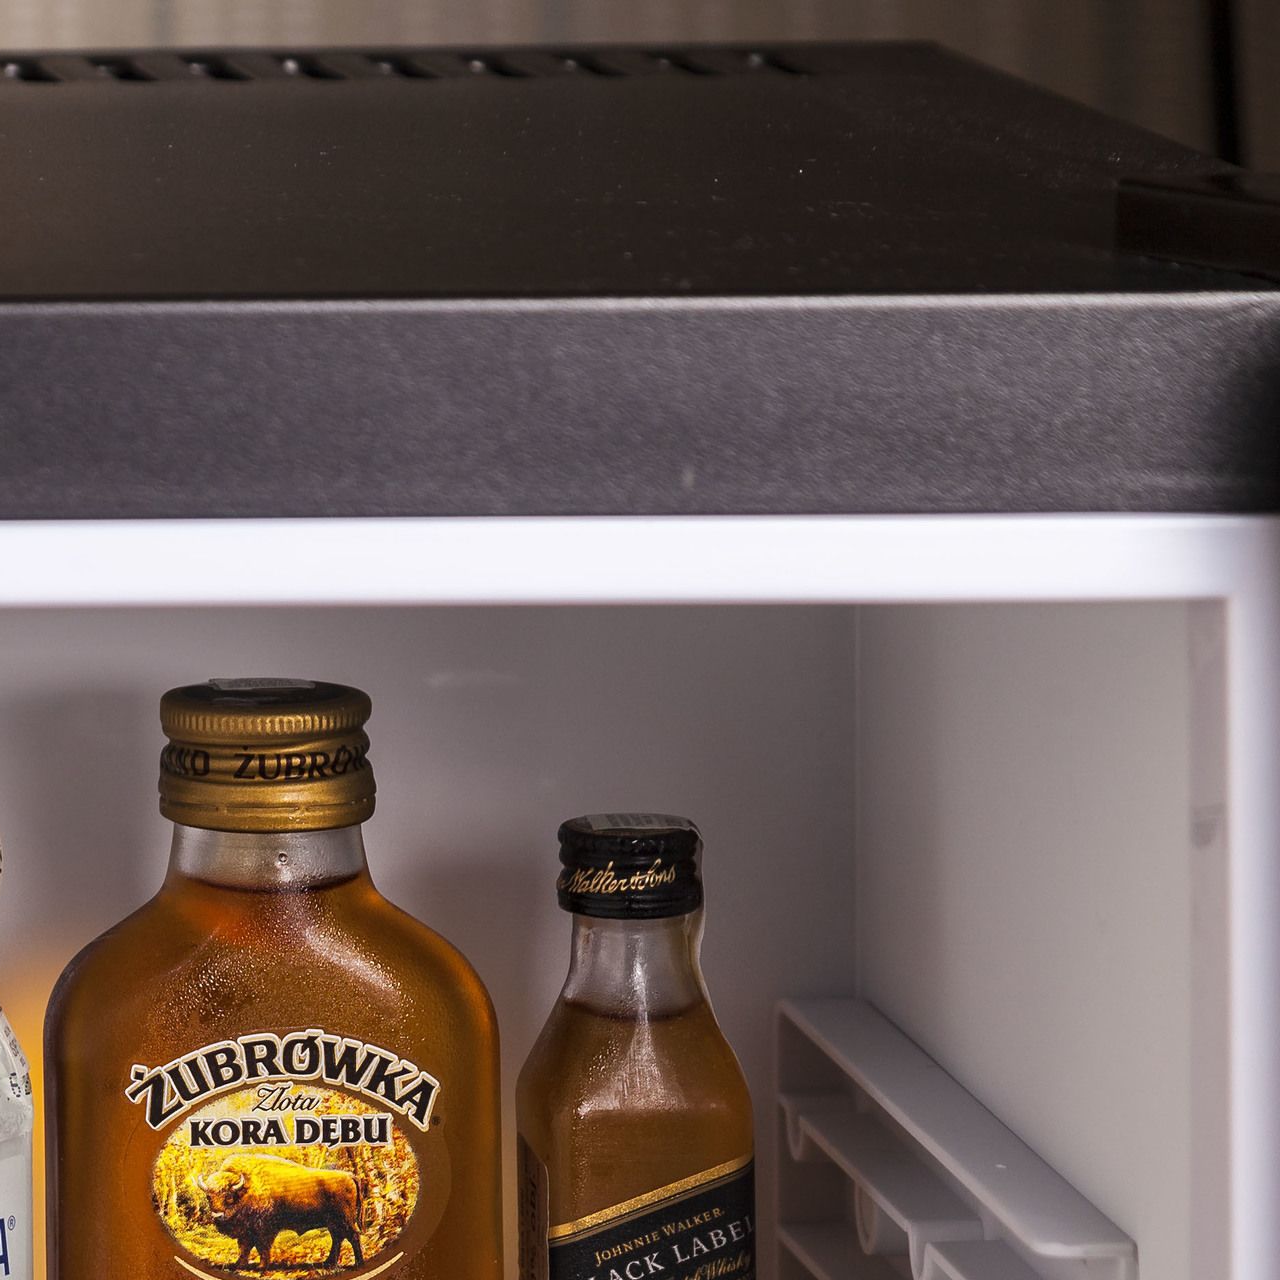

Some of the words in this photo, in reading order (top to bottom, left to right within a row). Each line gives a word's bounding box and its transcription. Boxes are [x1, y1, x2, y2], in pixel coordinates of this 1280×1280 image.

[126, 1029, 441, 1132] ŻUBRÓWKA
[251, 1084, 321, 1113] Złota
[189, 1119, 287, 1147] KORA
[293, 1115, 390, 1147] DĘBU
[594, 1232, 660, 1267] JOHNNIE
